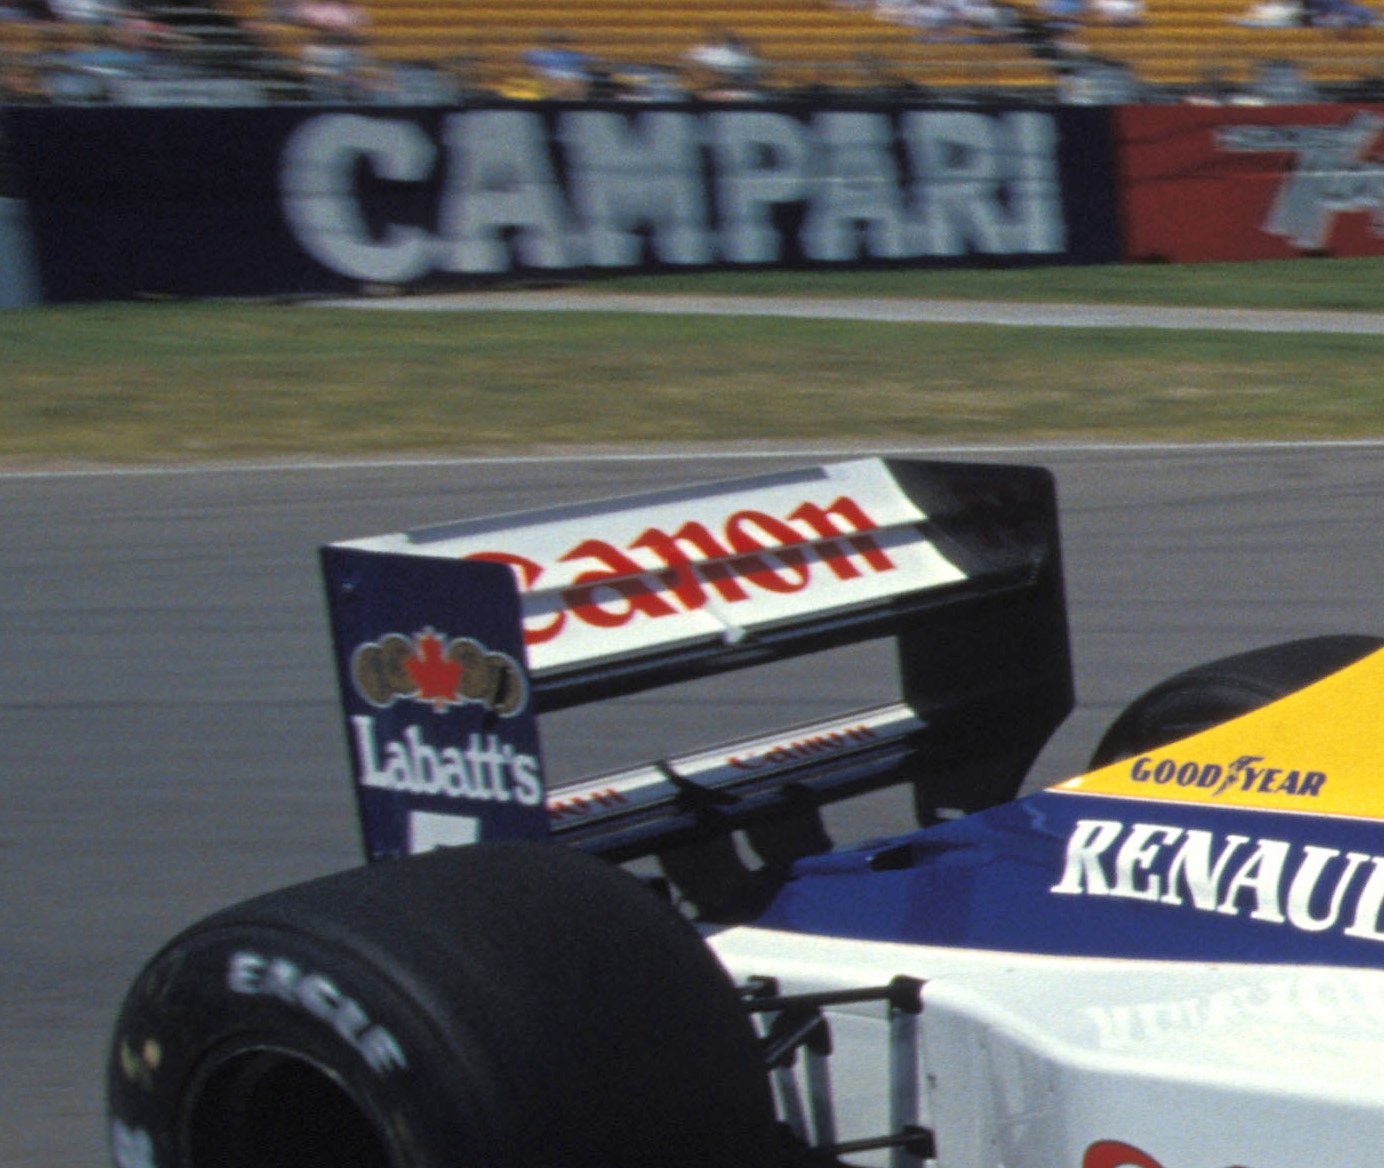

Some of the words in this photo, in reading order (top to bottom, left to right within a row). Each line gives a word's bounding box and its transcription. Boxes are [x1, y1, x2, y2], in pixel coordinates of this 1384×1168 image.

[280, 110, 1067, 283] CAMPARI
[351, 714, 542, 806] Labatt's
[1129, 753, 1327, 799] GOODYEAR
